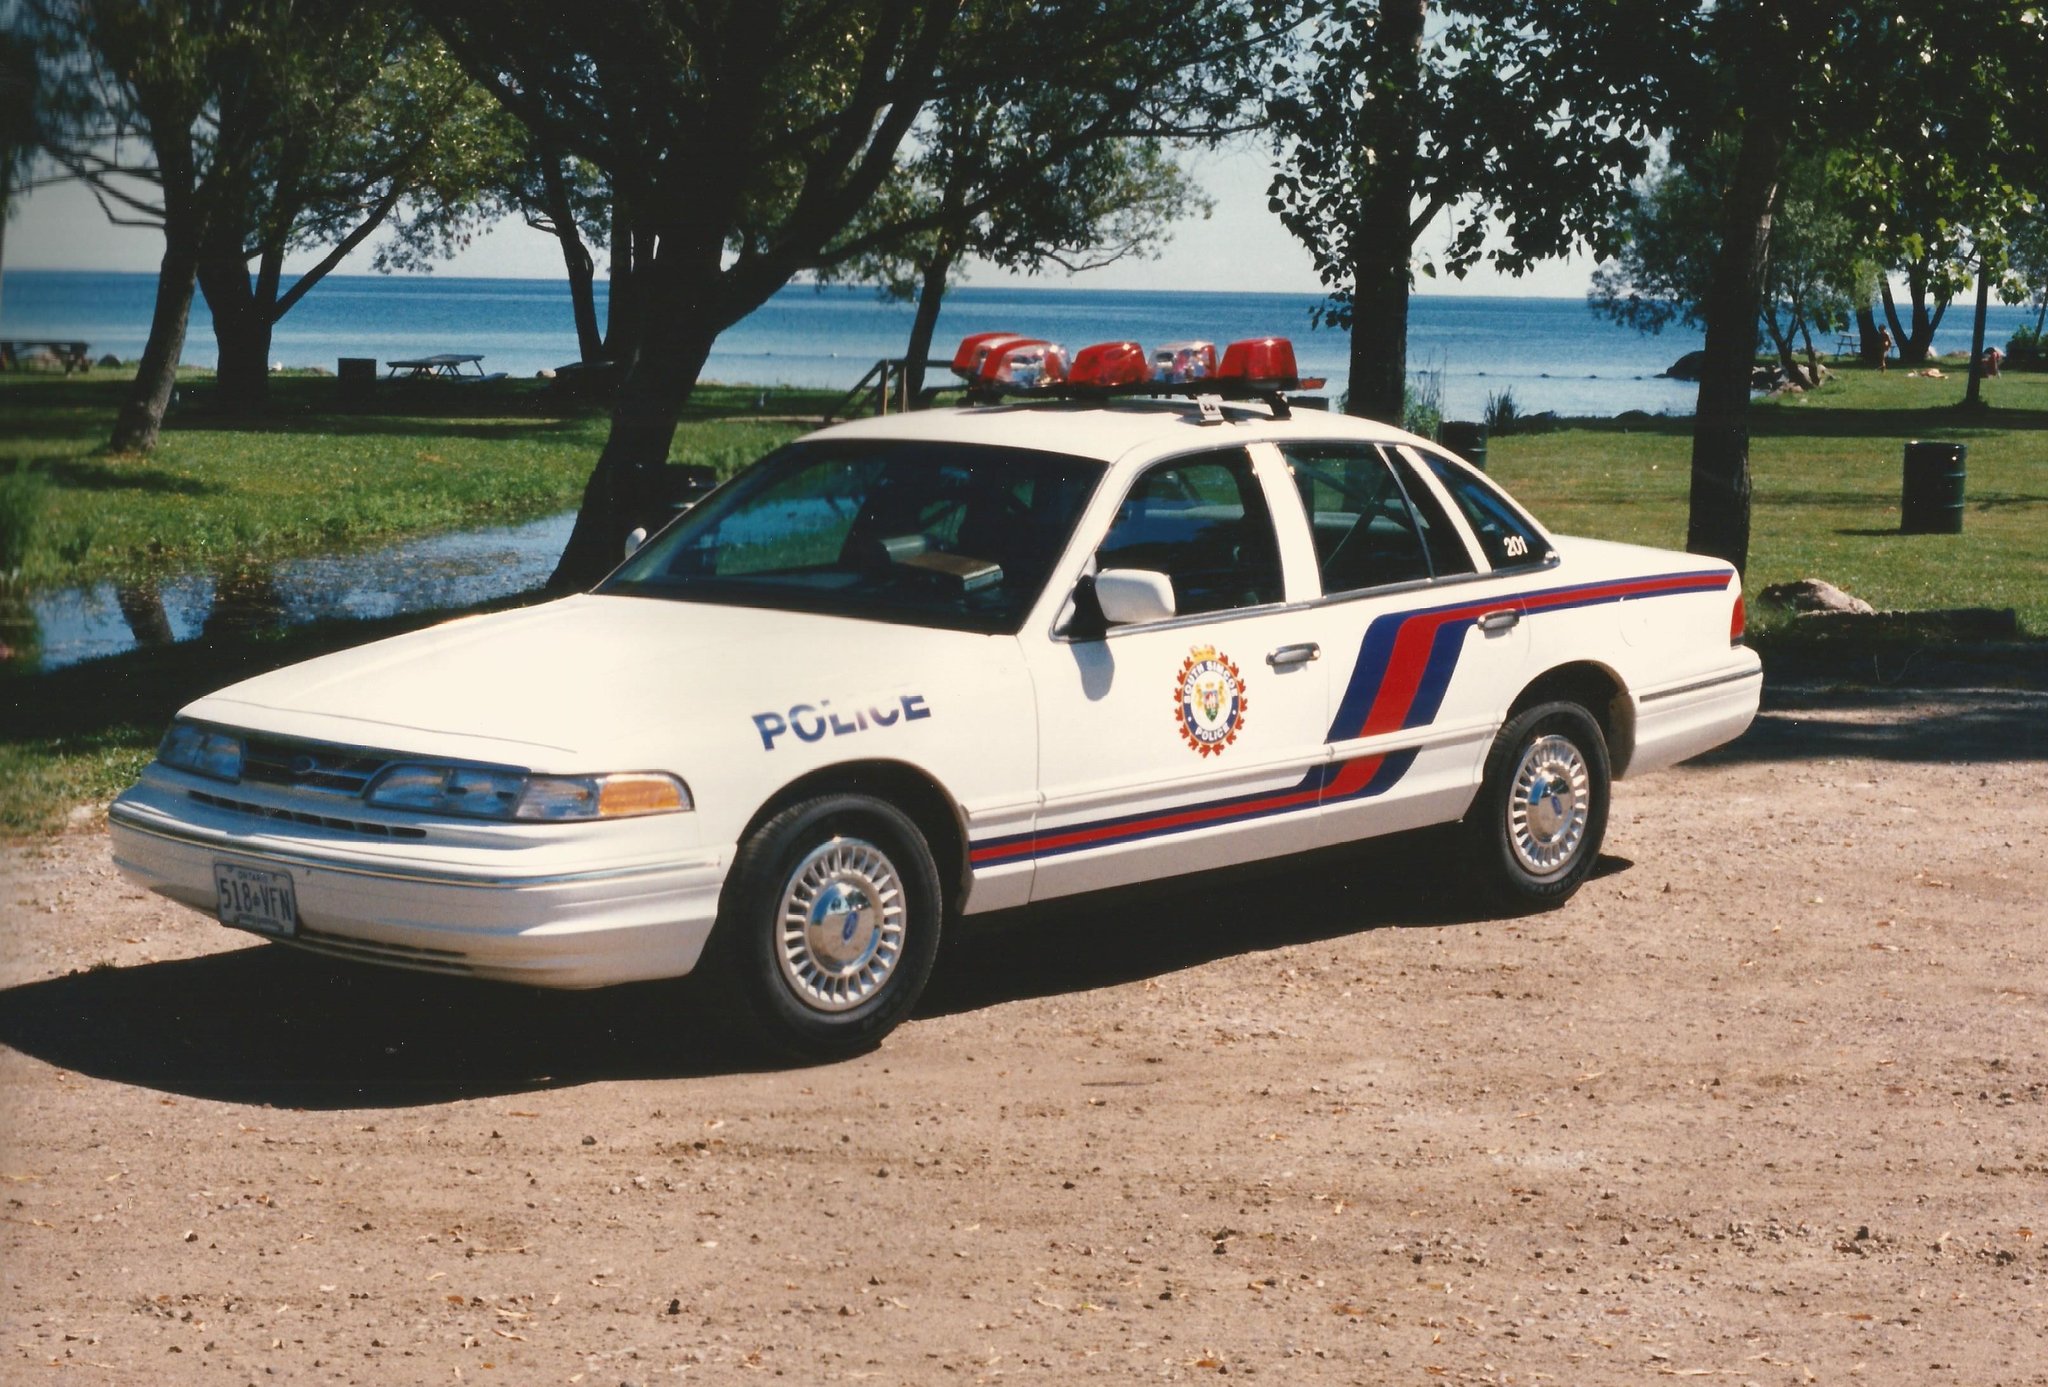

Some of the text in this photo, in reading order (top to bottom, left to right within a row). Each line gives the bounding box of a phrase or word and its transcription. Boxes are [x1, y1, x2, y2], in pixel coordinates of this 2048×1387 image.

[1503, 535, 1529, 557] 201
[751, 694, 932, 751] POLICE
[238, 870, 268, 883] ONTAR
